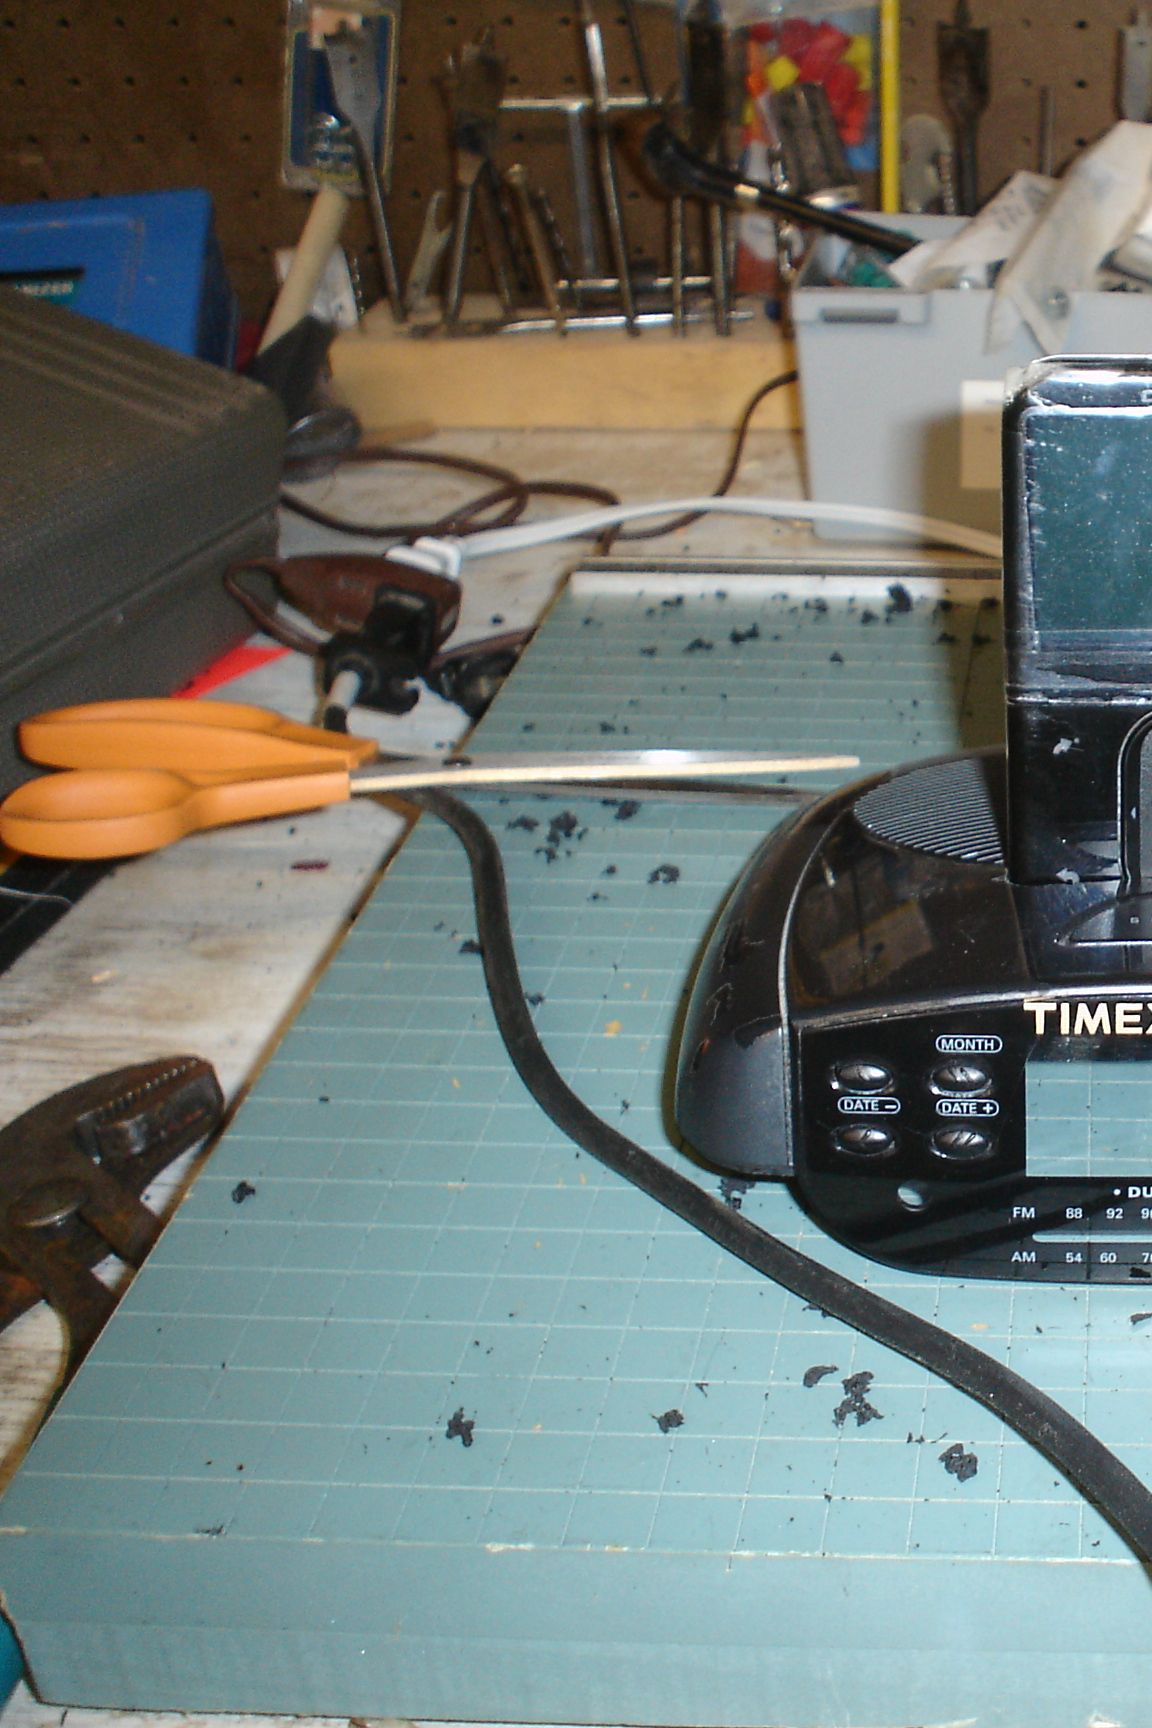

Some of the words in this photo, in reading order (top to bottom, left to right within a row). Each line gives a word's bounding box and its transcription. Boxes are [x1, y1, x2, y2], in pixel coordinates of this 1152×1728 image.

[940, 1038, 995, 1051] MONTH
[843, 1099, 879, 1112] DATE
[941, 1101, 977, 1115] DATE
[1012, 1206, 1035, 1219] FM
[1065, 1207, 1083, 1219] 88
[1106, 1207, 1124, 1219] 92
[1011, 1251, 1036, 1263] AM
[1065, 1252, 1083, 1263] 54
[1099, 1252, 1117, 1263] 60
